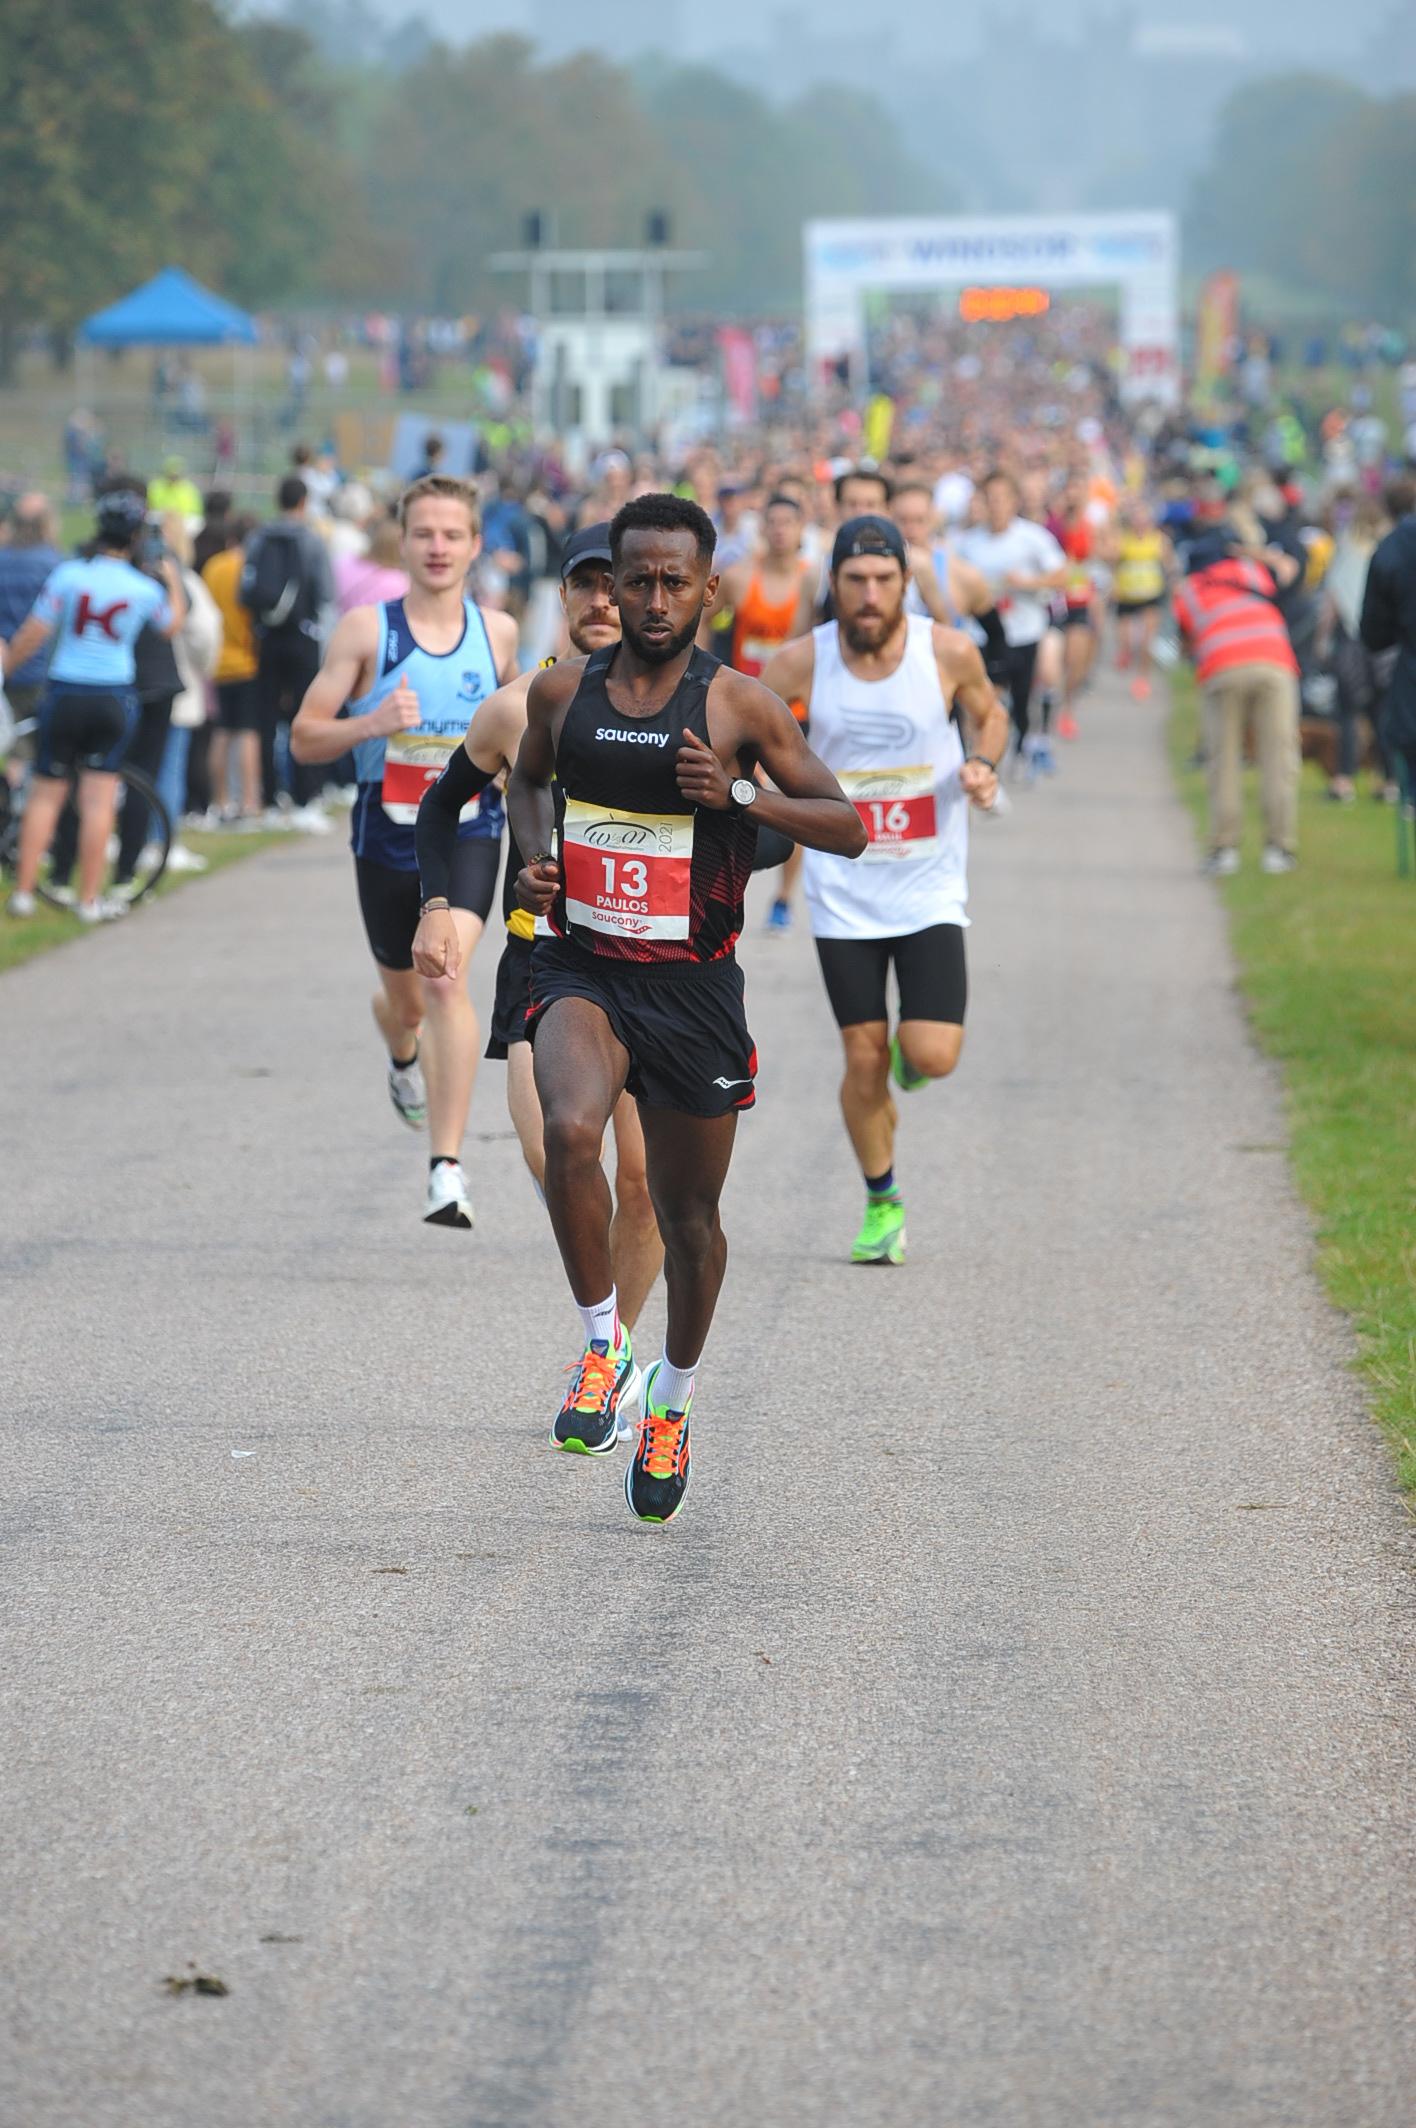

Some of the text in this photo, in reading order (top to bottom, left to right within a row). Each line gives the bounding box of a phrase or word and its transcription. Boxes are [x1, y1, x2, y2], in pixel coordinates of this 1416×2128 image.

[594, 727, 670, 748] saucony
[869, 801, 911, 832] 16
[658, 822, 673, 853] 2021
[601, 857, 648, 898] 13
[596, 895, 649, 913] PAULOS
[592, 911, 639, 928] saucony
